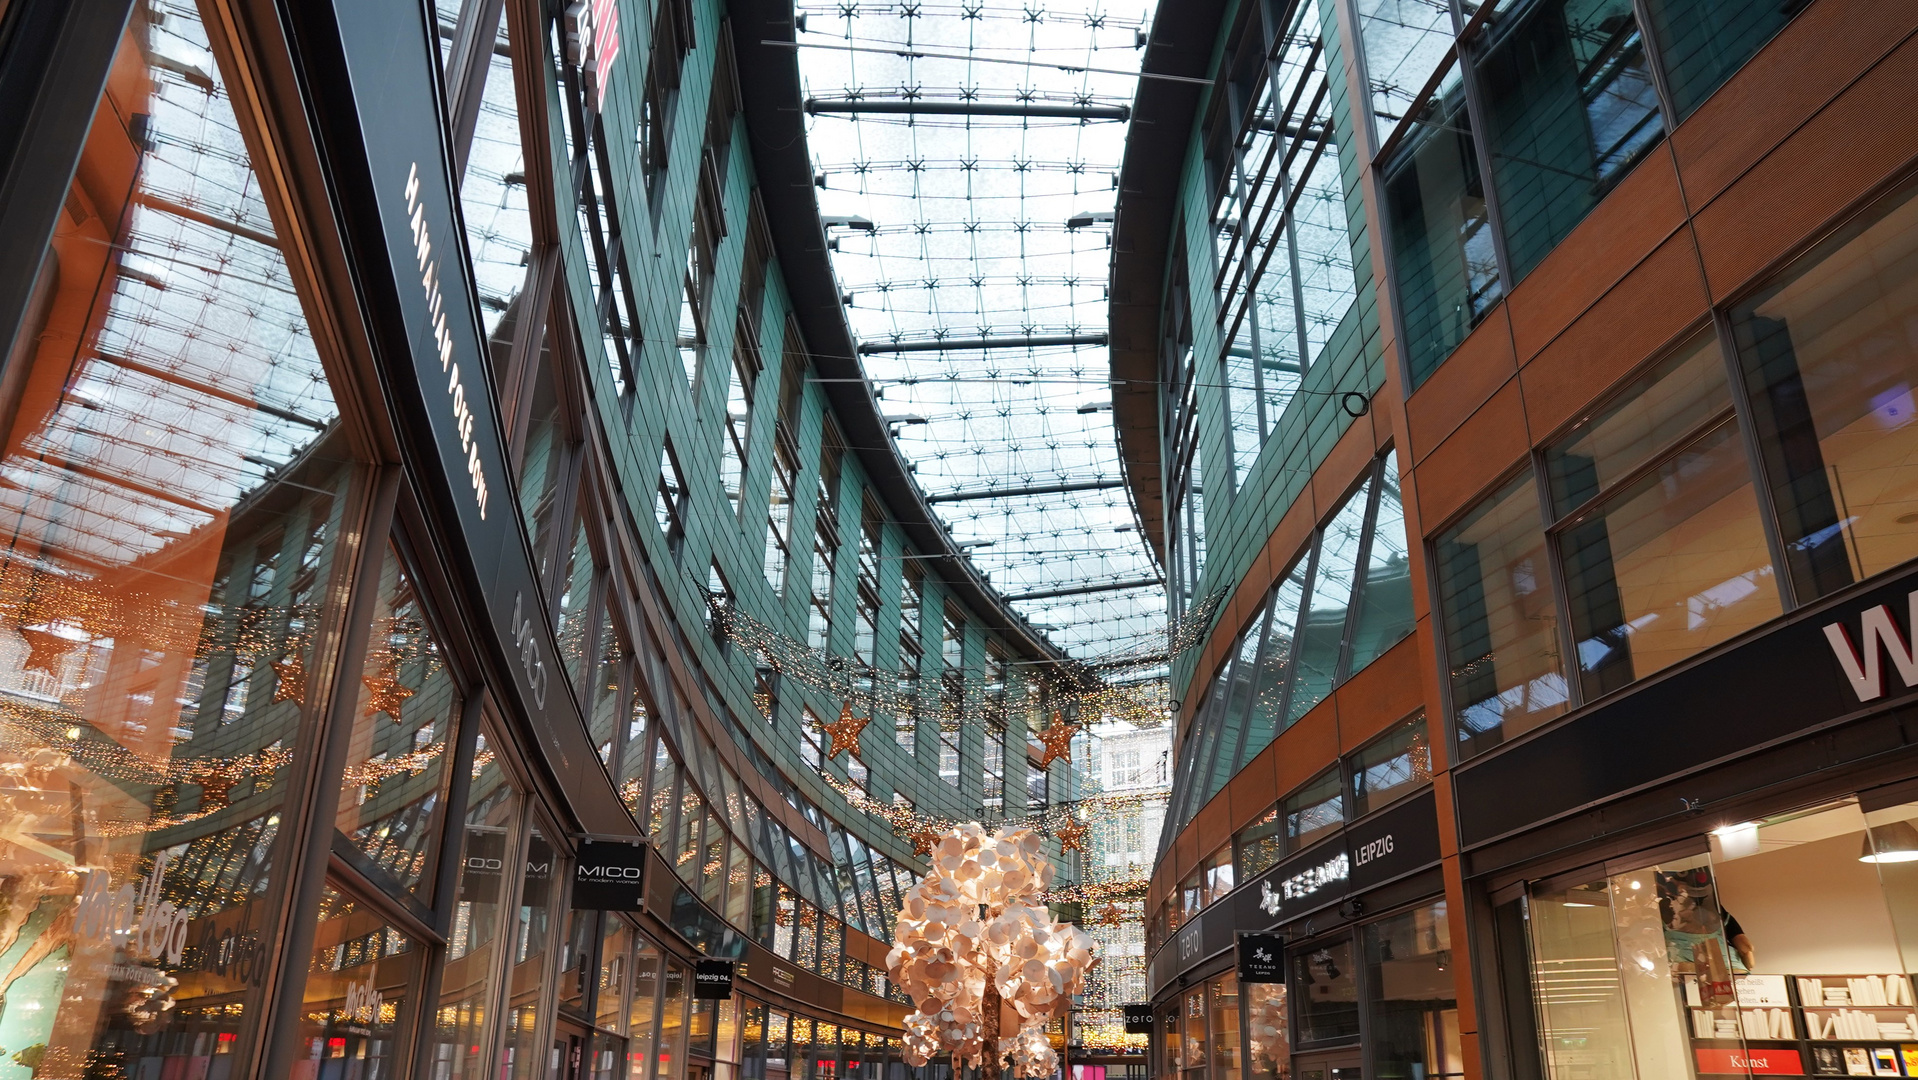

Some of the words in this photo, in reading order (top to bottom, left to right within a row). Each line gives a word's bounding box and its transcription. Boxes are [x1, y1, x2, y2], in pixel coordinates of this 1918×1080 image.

[405, 162, 452, 372] HAWAIIAN
[449, 362, 474, 453] POKÉ
[468, 441, 488, 521] BOWL
[511, 590, 547, 711] MICO
[1355, 834, 1394, 867] LEIPZIG
[578, 865, 641, 879] MICO
[1181, 930, 1199, 960] zero
[696, 973, 719, 982] leipzig
[1125, 1014, 1153, 1023] zero
[1730, 1055, 1770, 1068] Kunst
